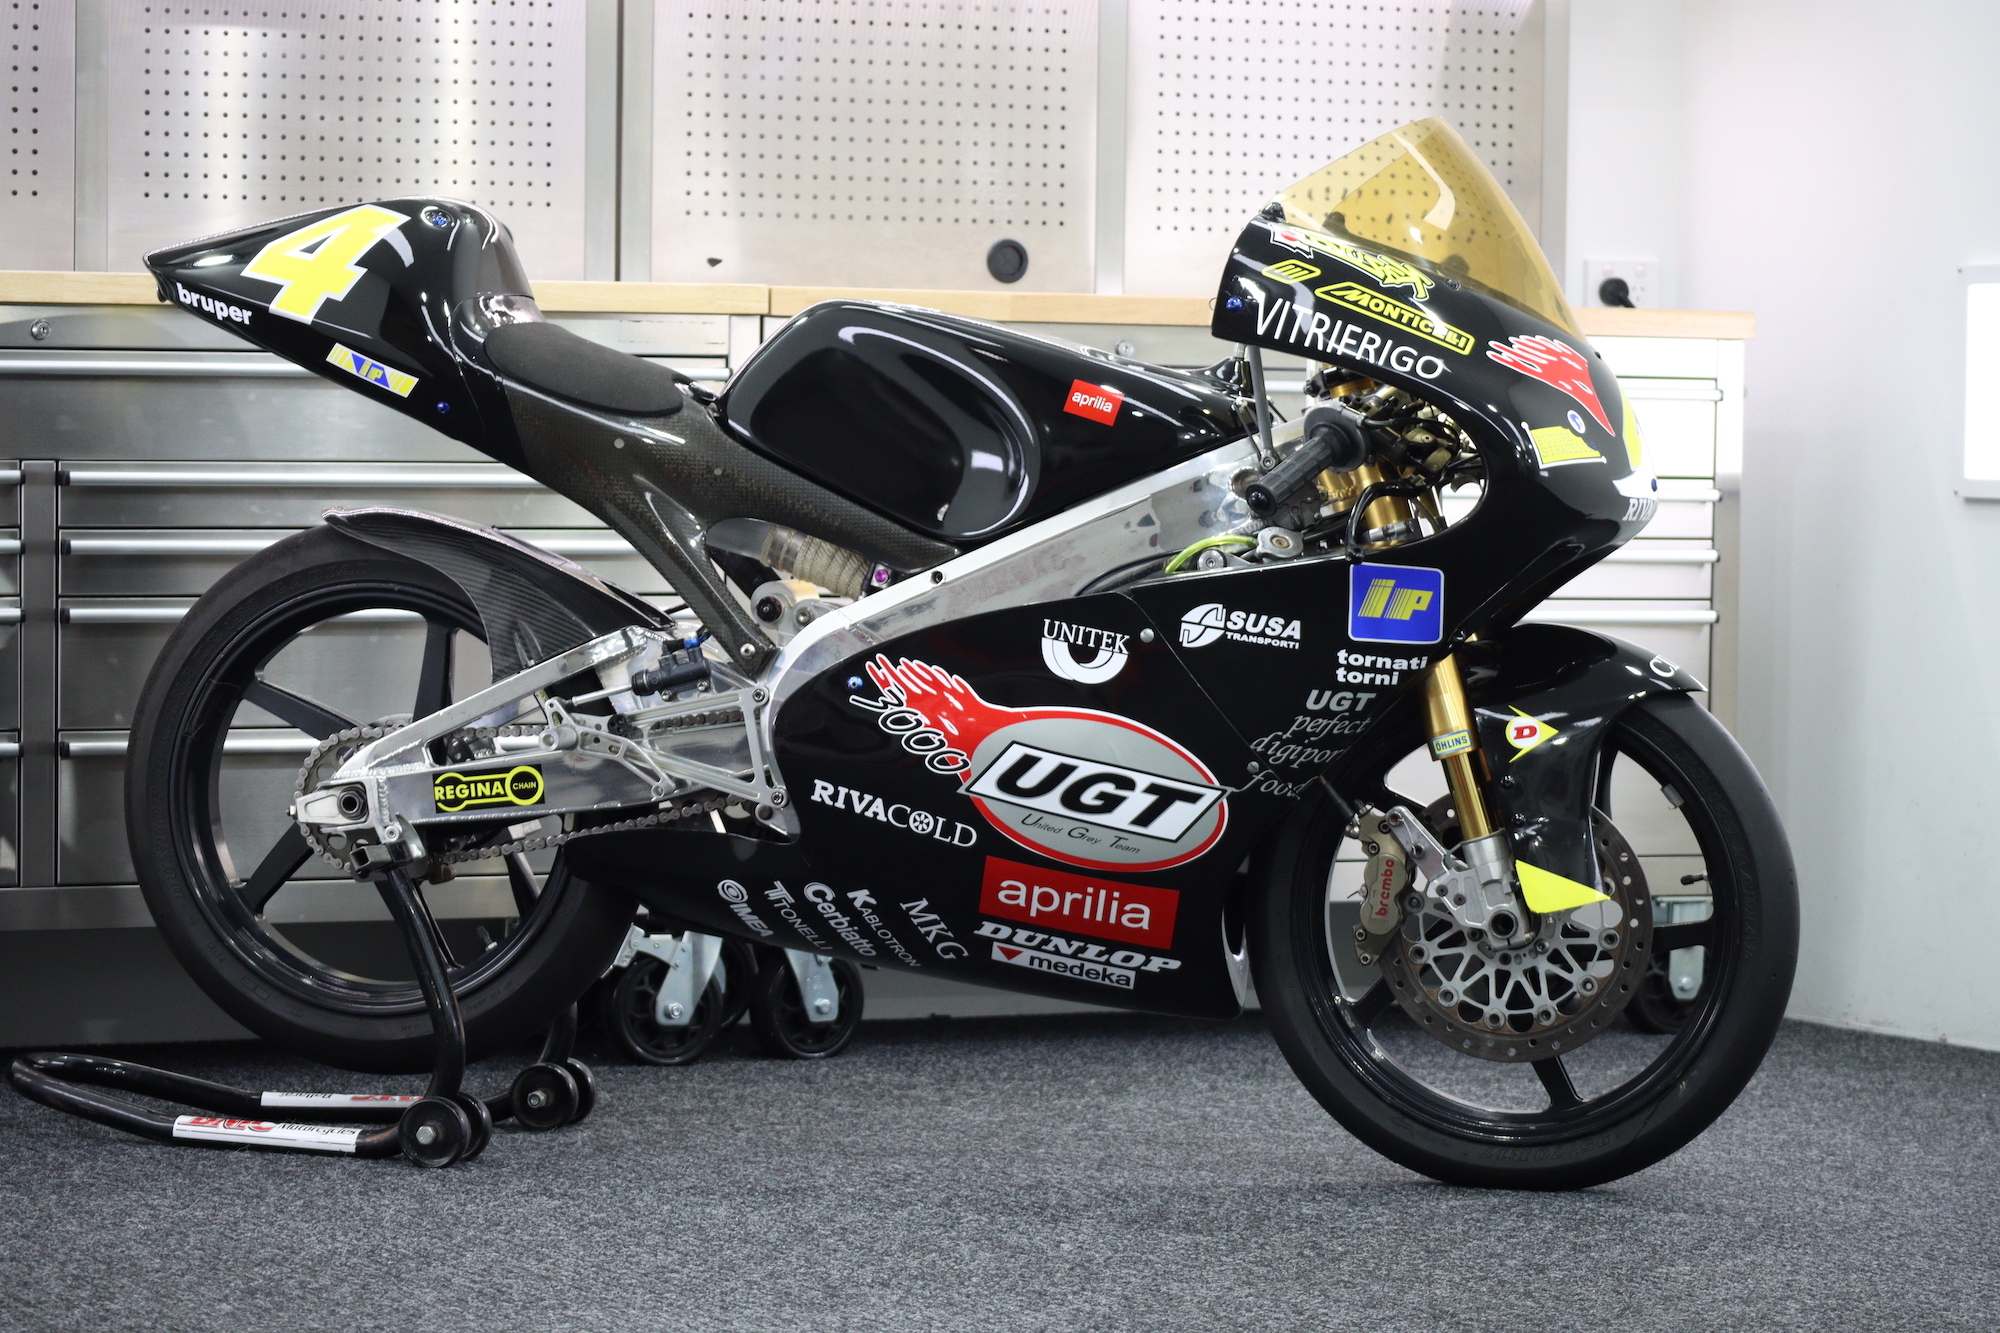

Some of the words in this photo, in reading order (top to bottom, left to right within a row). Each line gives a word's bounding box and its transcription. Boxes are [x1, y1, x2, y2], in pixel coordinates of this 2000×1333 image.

[241, 204, 411, 325] 4
[177, 283, 252, 325] bruper
[1256, 298, 1445, 380] VITRIERIGO
[1072, 391, 1113, 413] aprilia
[1043, 618, 1129, 654] UNITEK
[1225, 631, 1299, 649] TRANSPORTI
[1226, 610, 1300, 640] SUSA
[1336, 667, 1399, 685] torni
[1337, 649, 1428, 670] tornati
[1306, 689, 1377, 712] UGT
[849, 694, 971, 774] 3000
[1282, 712, 1371, 740] perfect
[1435, 735, 1468, 752] ÖHLINS
[434, 784, 505, 802] REGINA
[512, 780, 537, 791] CHAIN
[995, 753, 1206, 829] UGT
[810, 779, 978, 848] RIVACOLD
[1021, 812, 1063, 834] United
[1067, 826, 1102, 845] Grey
[1109, 835, 1141, 853] Team
[997, 876, 1151, 931] aprilia
[1375, 859, 1395, 916] brembo
[803, 882, 877, 957] Cerbiatto
[900, 897, 969, 960] MKG
[973, 920, 1182, 973] DUNLOP
[1028, 955, 1132, 987] medeka
